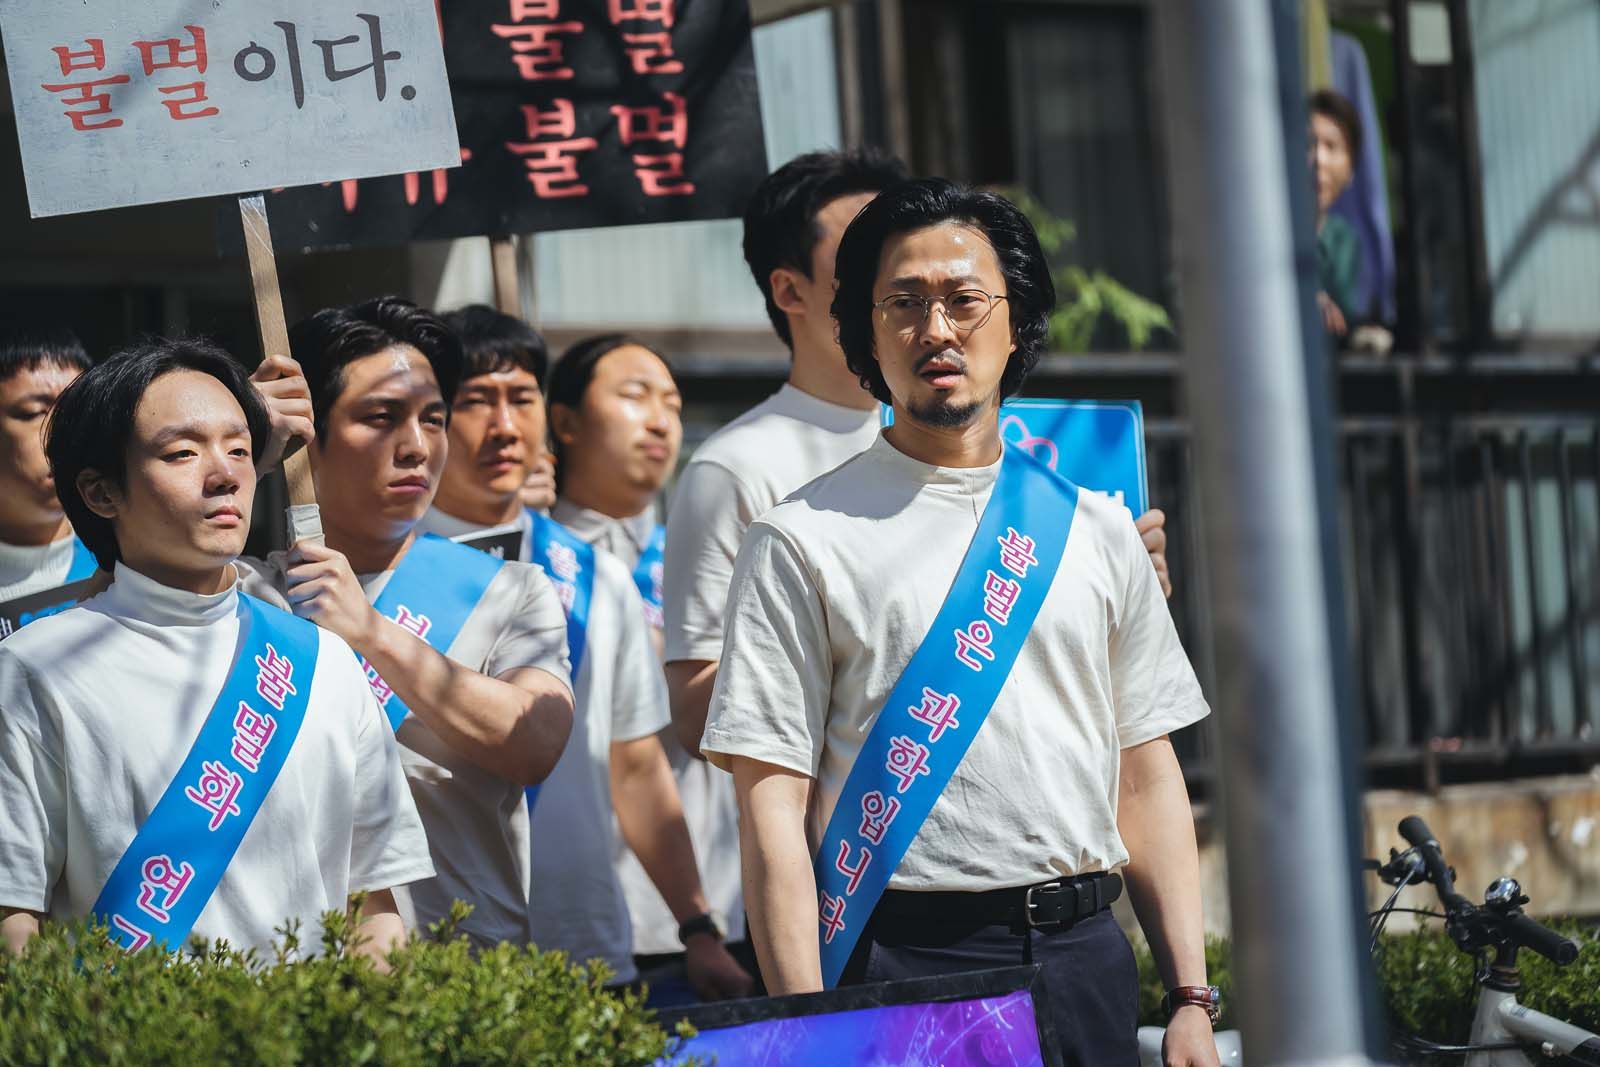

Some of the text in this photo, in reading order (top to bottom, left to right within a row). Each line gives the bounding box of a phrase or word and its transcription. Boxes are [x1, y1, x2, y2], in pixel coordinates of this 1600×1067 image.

[41, 13, 417, 131] 불멸이다.
[491, 0, 684, 80] 불멸
[506, 92, 695, 198] 불멸
[819, 527, 1038, 944] 불멸은 과학입니다
